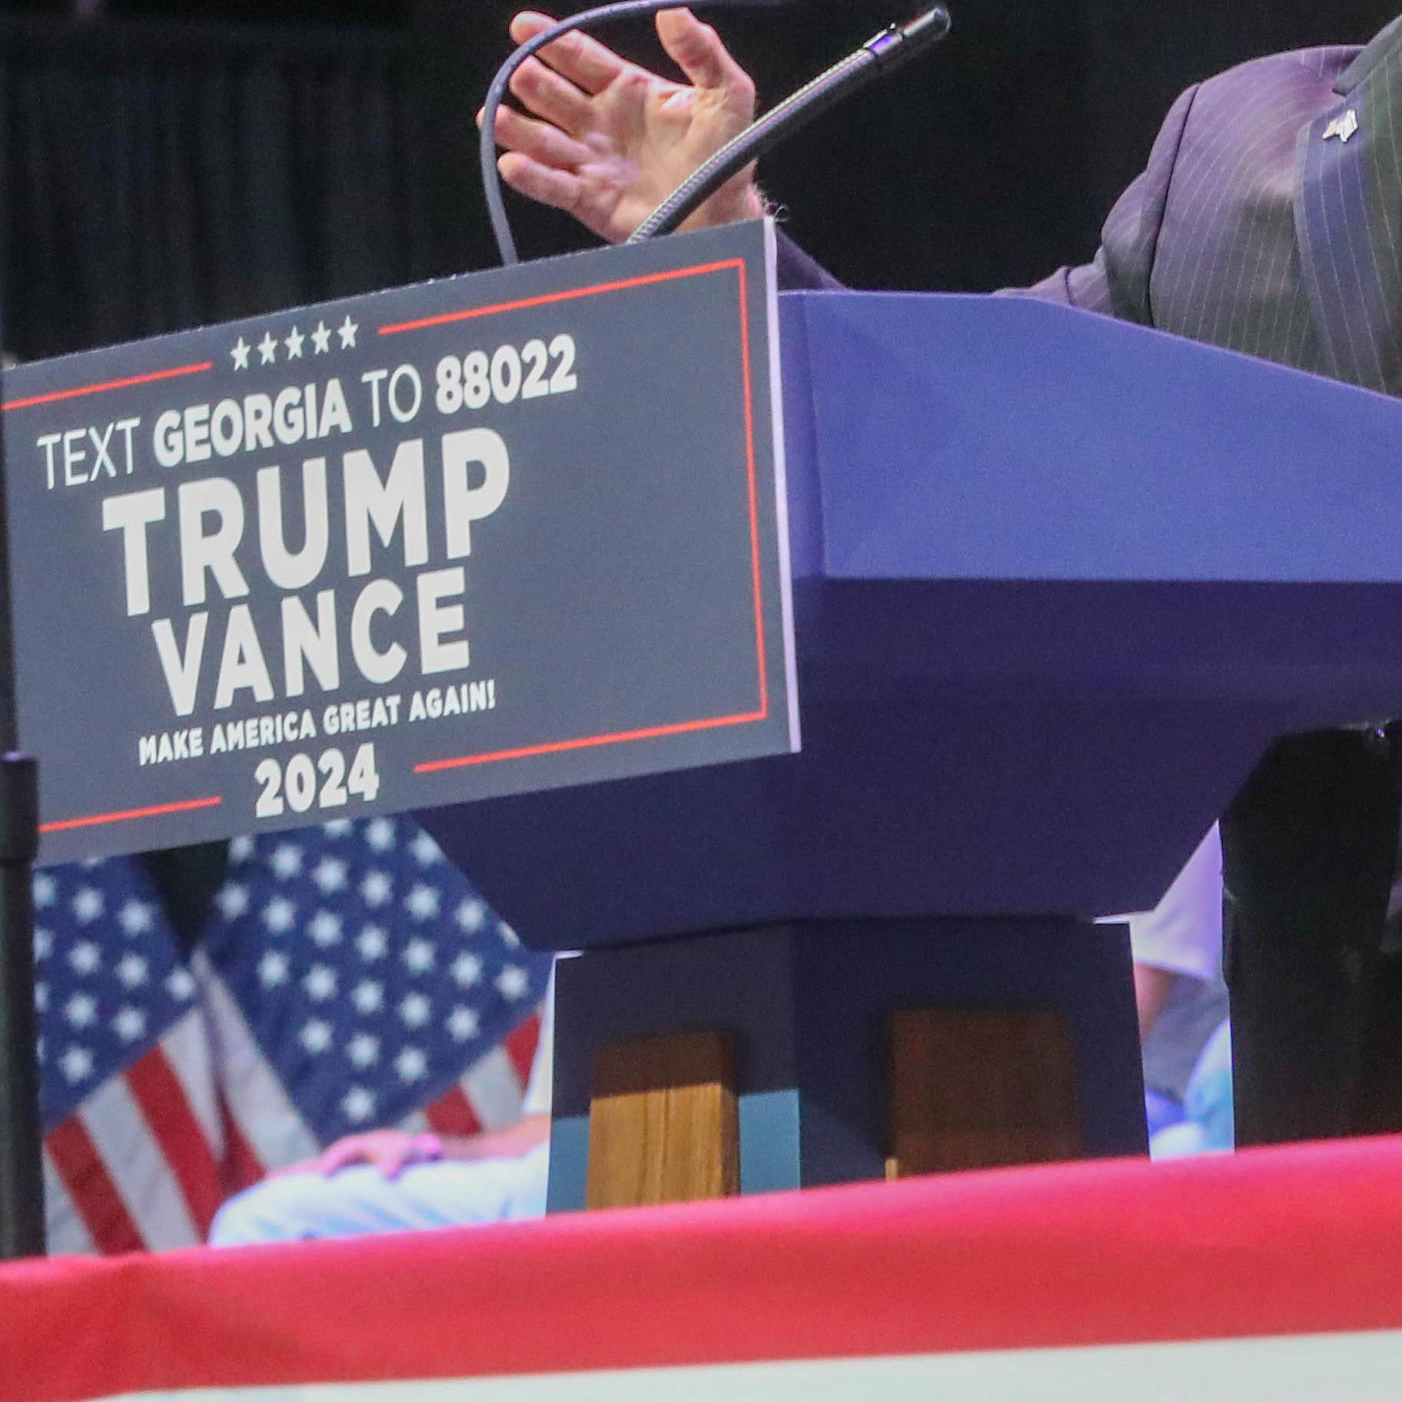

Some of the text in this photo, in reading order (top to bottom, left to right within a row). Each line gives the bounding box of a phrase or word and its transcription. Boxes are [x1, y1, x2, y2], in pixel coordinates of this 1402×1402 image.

[37, 333, 578, 490] TEXT GEORGIA TO 88022
[102, 426, 511, 617] TRUMP
[153, 566, 470, 718] VANCE
[139, 679, 496, 767] MAKE AMERICA GREAT AGAIN!
[254, 742, 380, 818] 2024
